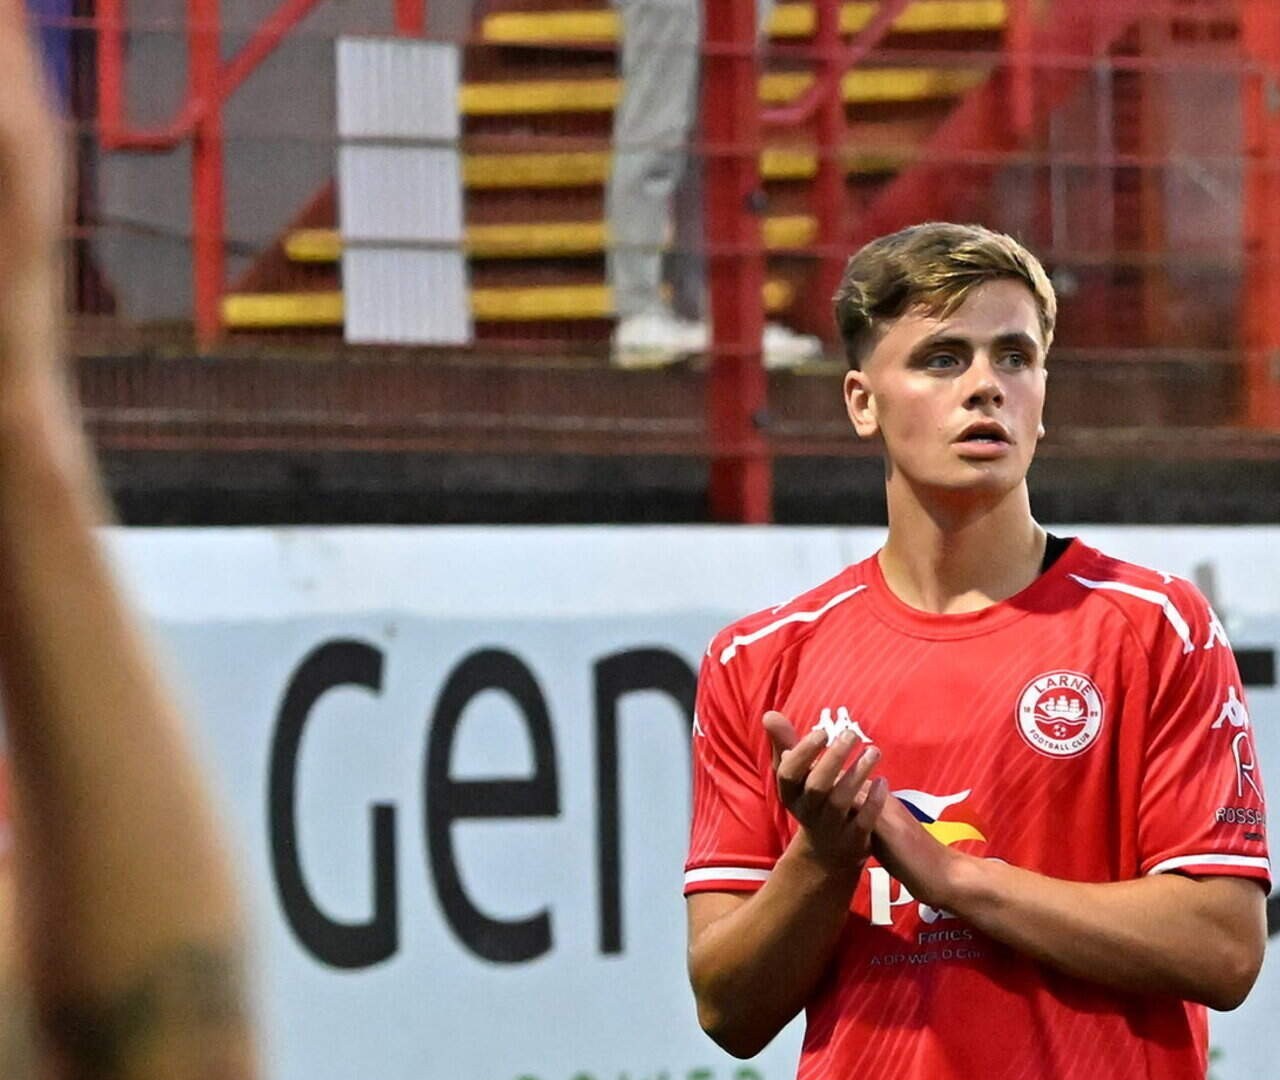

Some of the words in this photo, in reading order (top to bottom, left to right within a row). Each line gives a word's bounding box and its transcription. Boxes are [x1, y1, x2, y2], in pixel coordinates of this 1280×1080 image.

[1034, 675, 1092, 696] LARNE
[1030, 729, 1069, 751] FOOTBALL
[1071, 732, 1090, 748] CLUB
